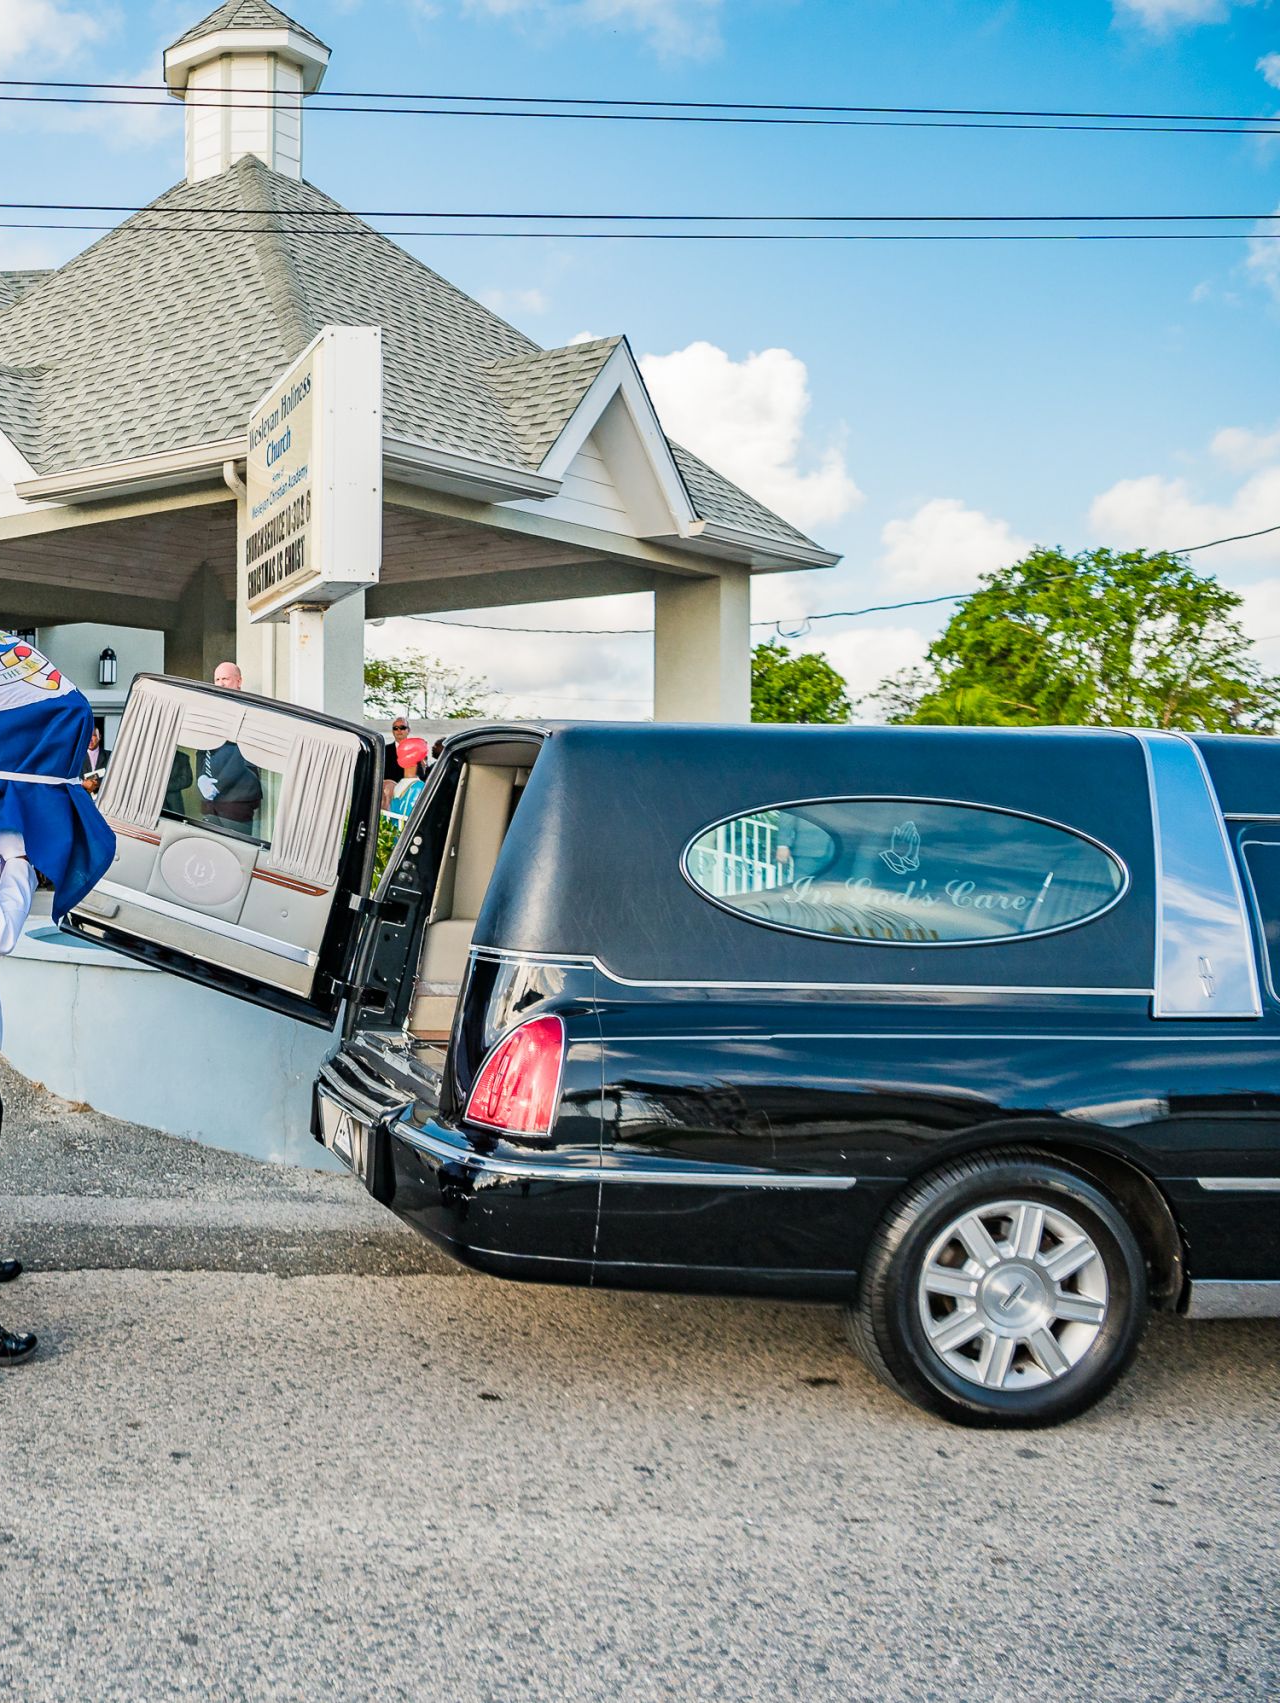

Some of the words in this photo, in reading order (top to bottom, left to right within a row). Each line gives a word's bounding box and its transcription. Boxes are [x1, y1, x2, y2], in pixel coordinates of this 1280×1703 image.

[249, 408, 279, 452] Wesleyan
[280, 372, 311, 421] Holiness
[266, 425, 291, 467] Church
[269, 482, 287, 505] Christian
[288, 464, 308, 487] Academy
[246, 526, 264, 566] CHURCH
[264, 510, 285, 553] SERVICE
[248, 556, 275, 600] CHRISTMAS
[277, 551, 283, 582] IS
[285, 534, 305, 577] CHRIST
[0, 669, 21, 680] THE
[783, 875, 834, 905] In
[845, 877, 939, 908] God's
[945, 880, 1034, 911] Care
